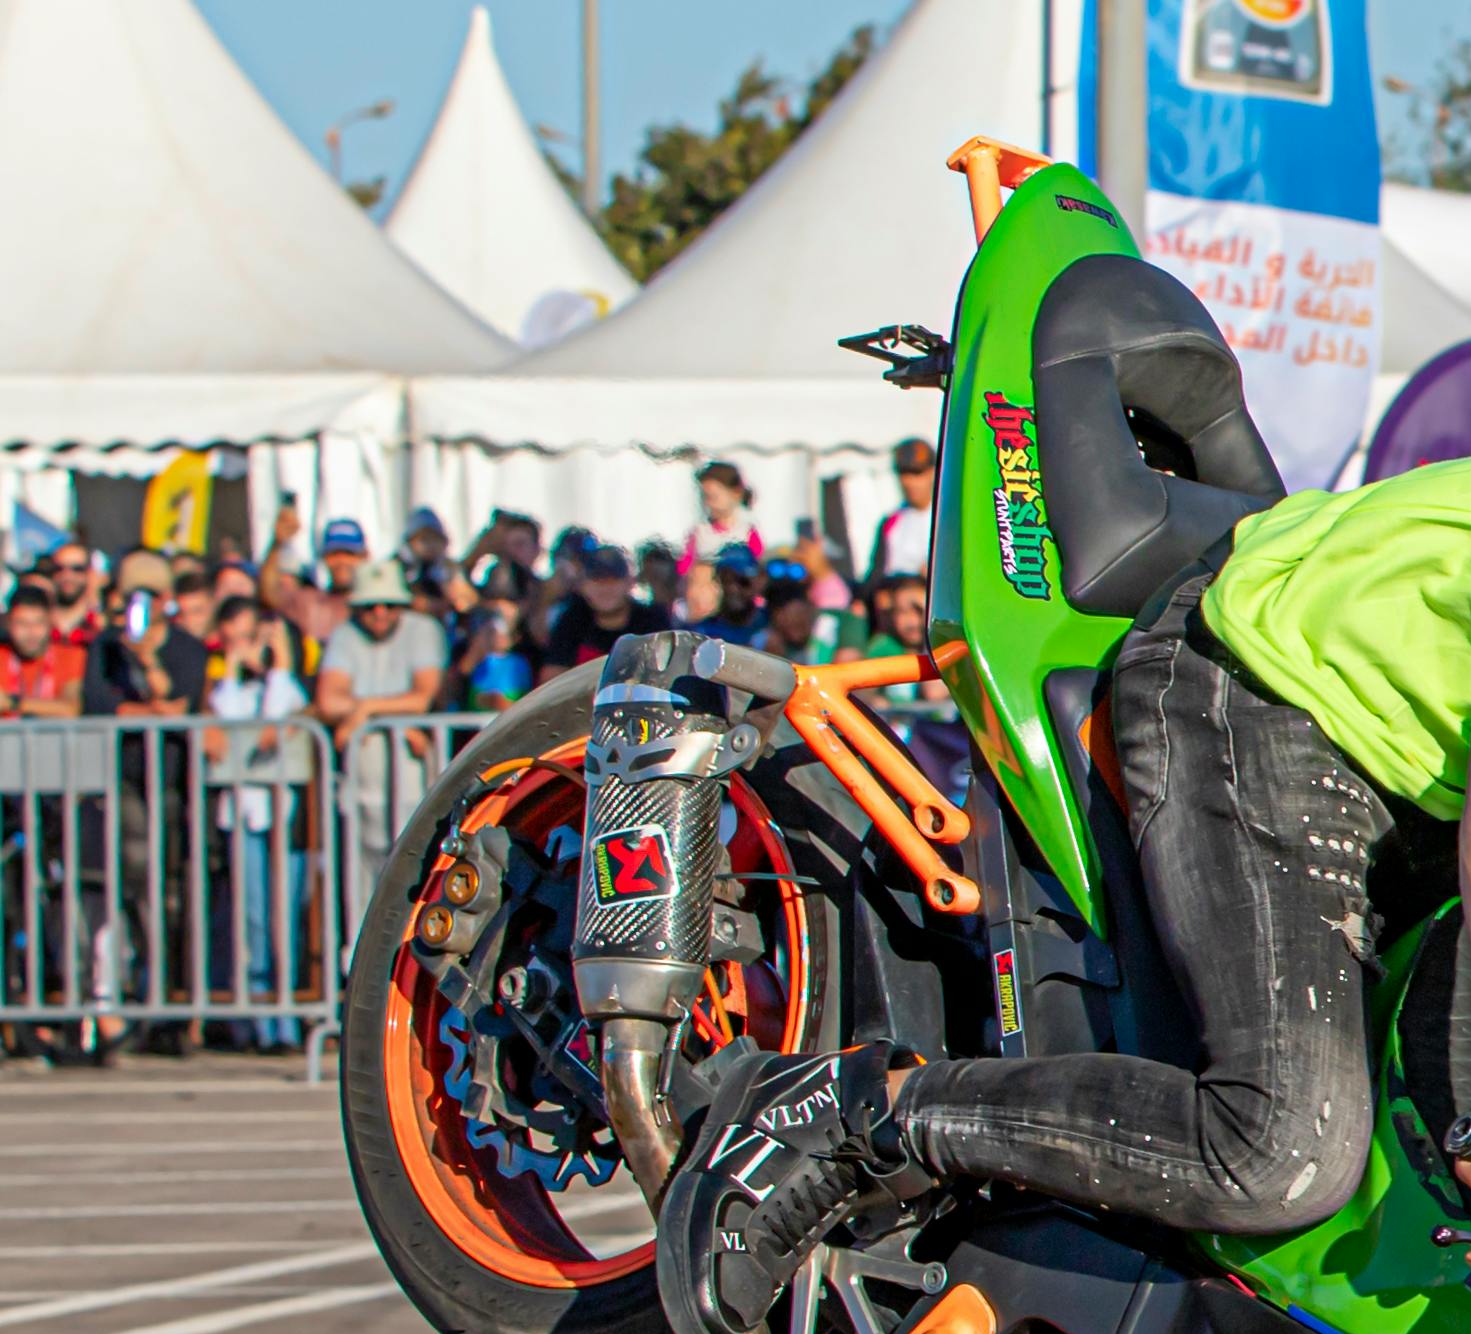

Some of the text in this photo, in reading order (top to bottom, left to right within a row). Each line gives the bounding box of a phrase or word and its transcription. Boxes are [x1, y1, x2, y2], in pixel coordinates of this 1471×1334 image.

[759, 1083, 841, 1131] VLTN
[706, 1123, 785, 1202] VL
[720, 1231, 746, 1251] VL
